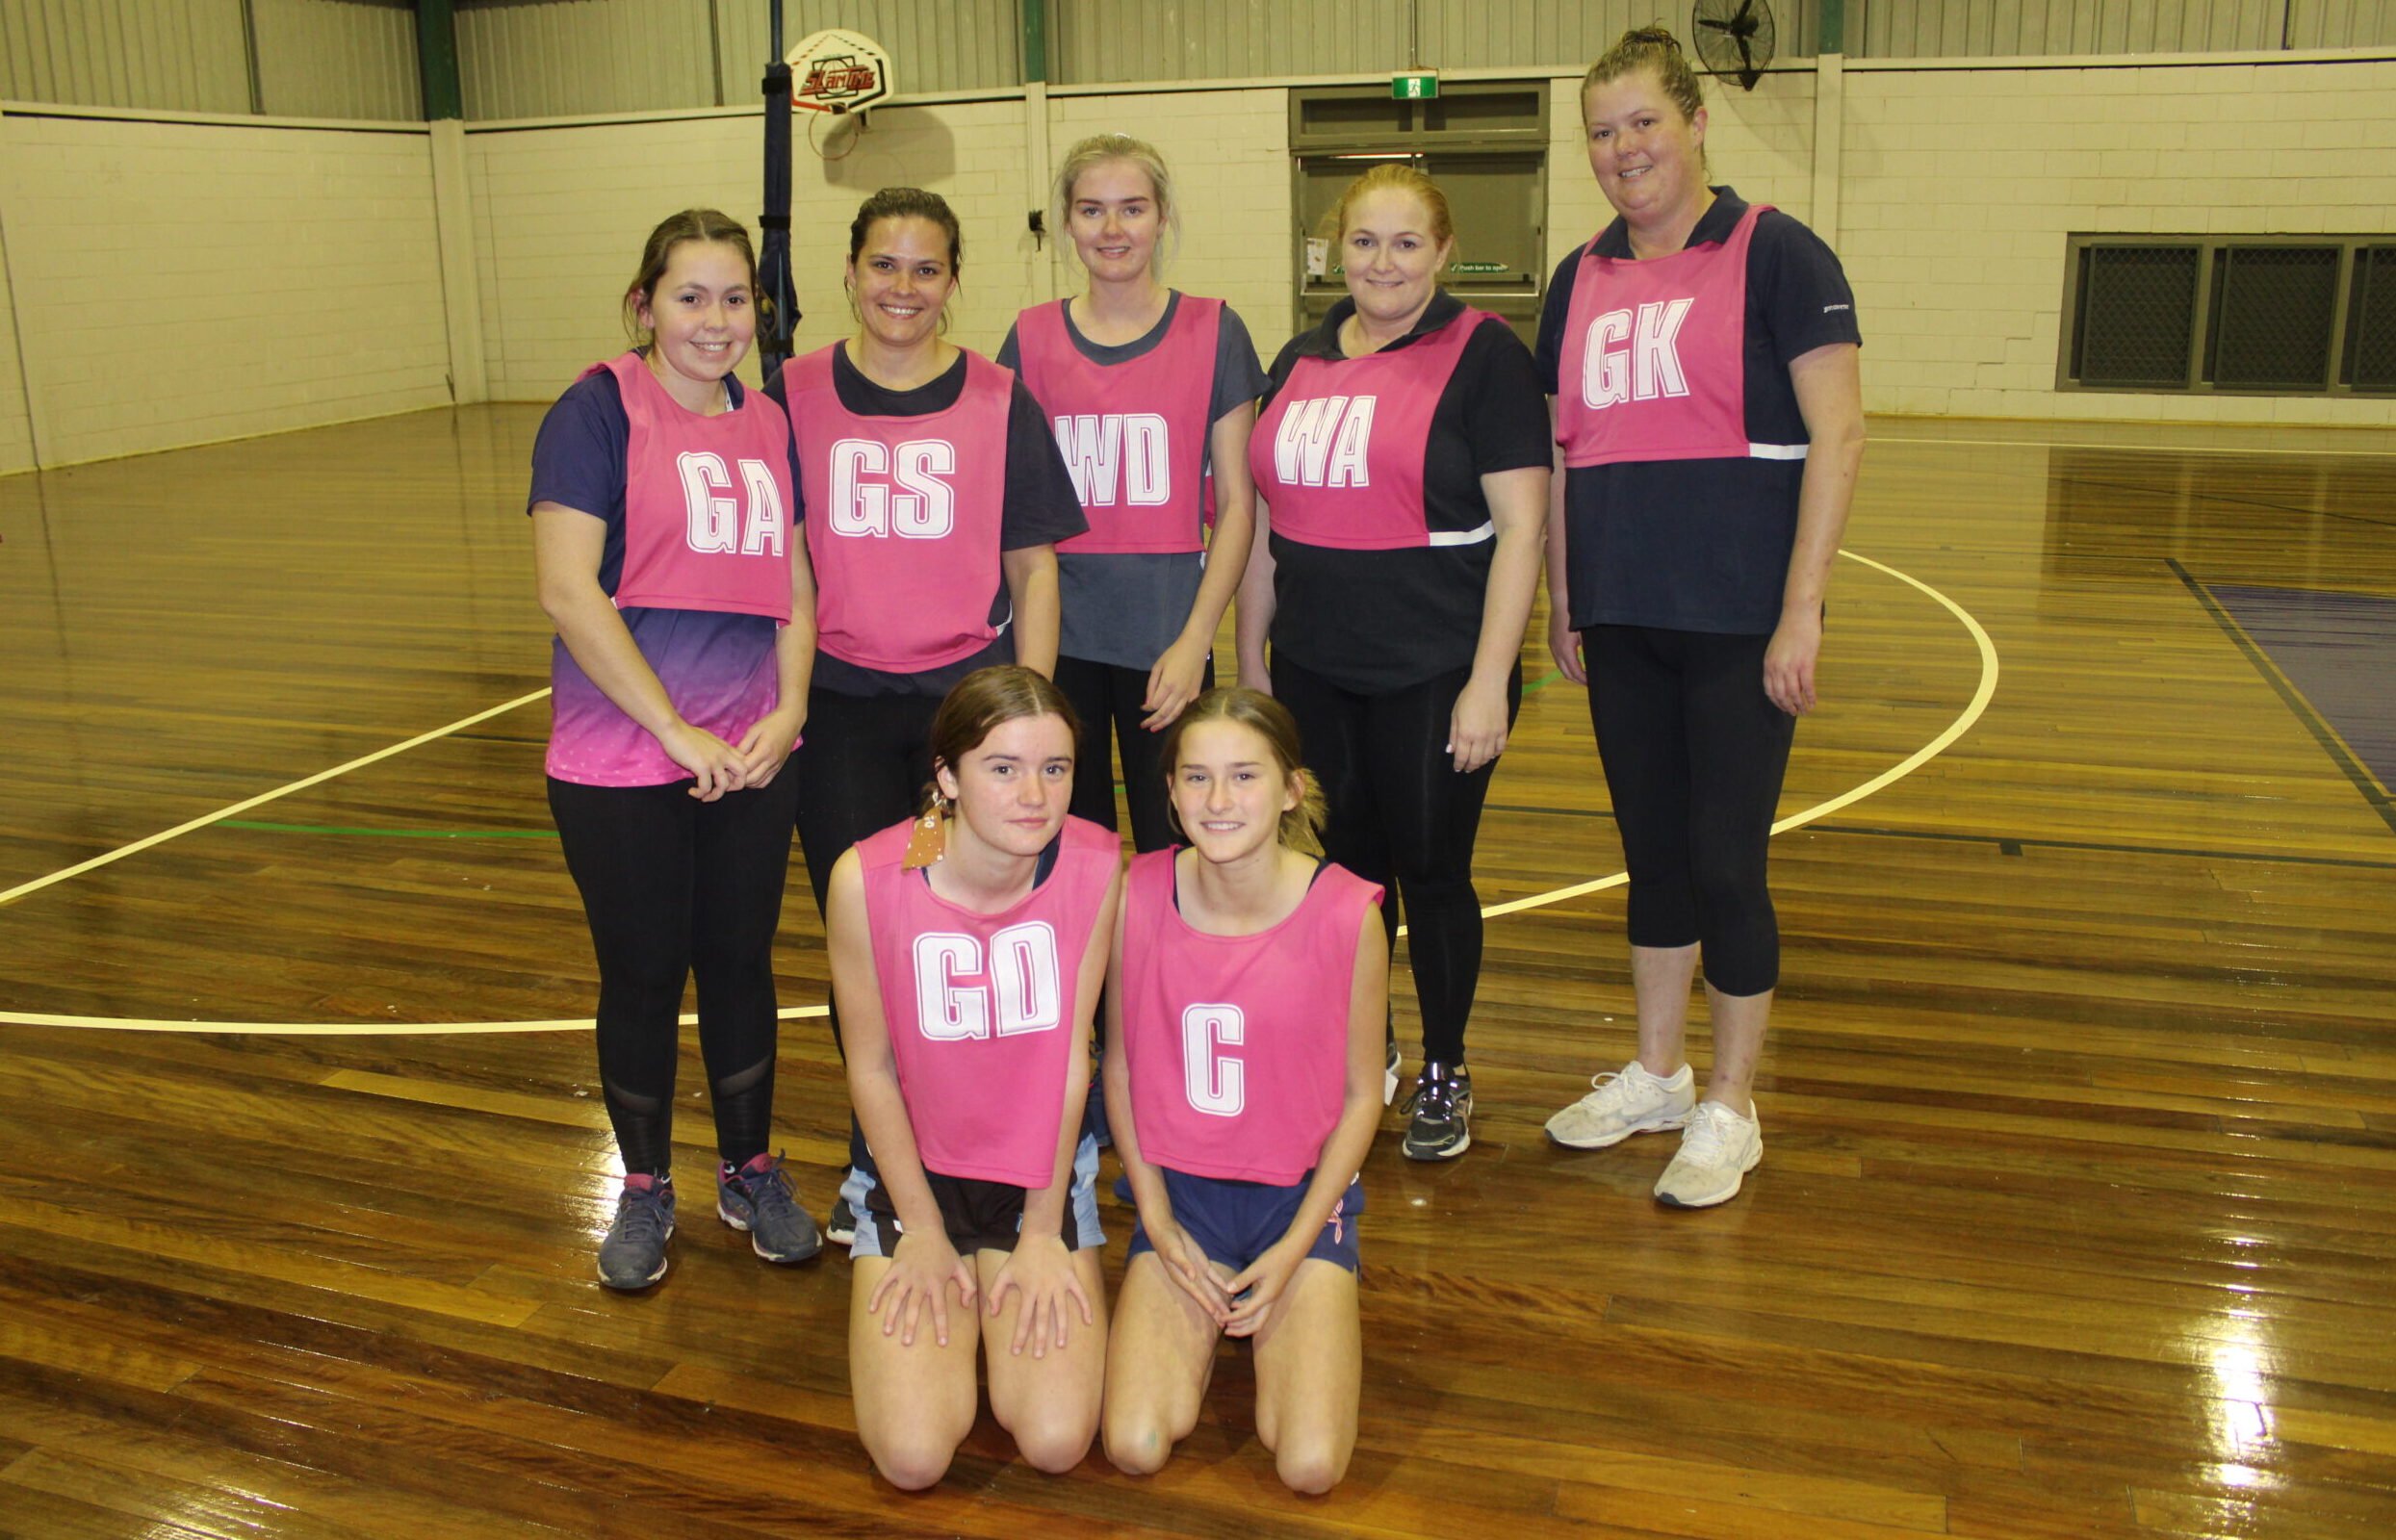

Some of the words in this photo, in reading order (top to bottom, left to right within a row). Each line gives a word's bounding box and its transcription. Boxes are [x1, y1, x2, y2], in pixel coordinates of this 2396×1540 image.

[1583, 296, 1696, 410] GK
[828, 437, 957, 540] GS
[1054, 412, 1171, 507] WD
[1274, 394, 1378, 488] WA
[675, 450, 785, 558] GA
[911, 918, 1064, 1042] GD
[1181, 1002, 1246, 1117] C
